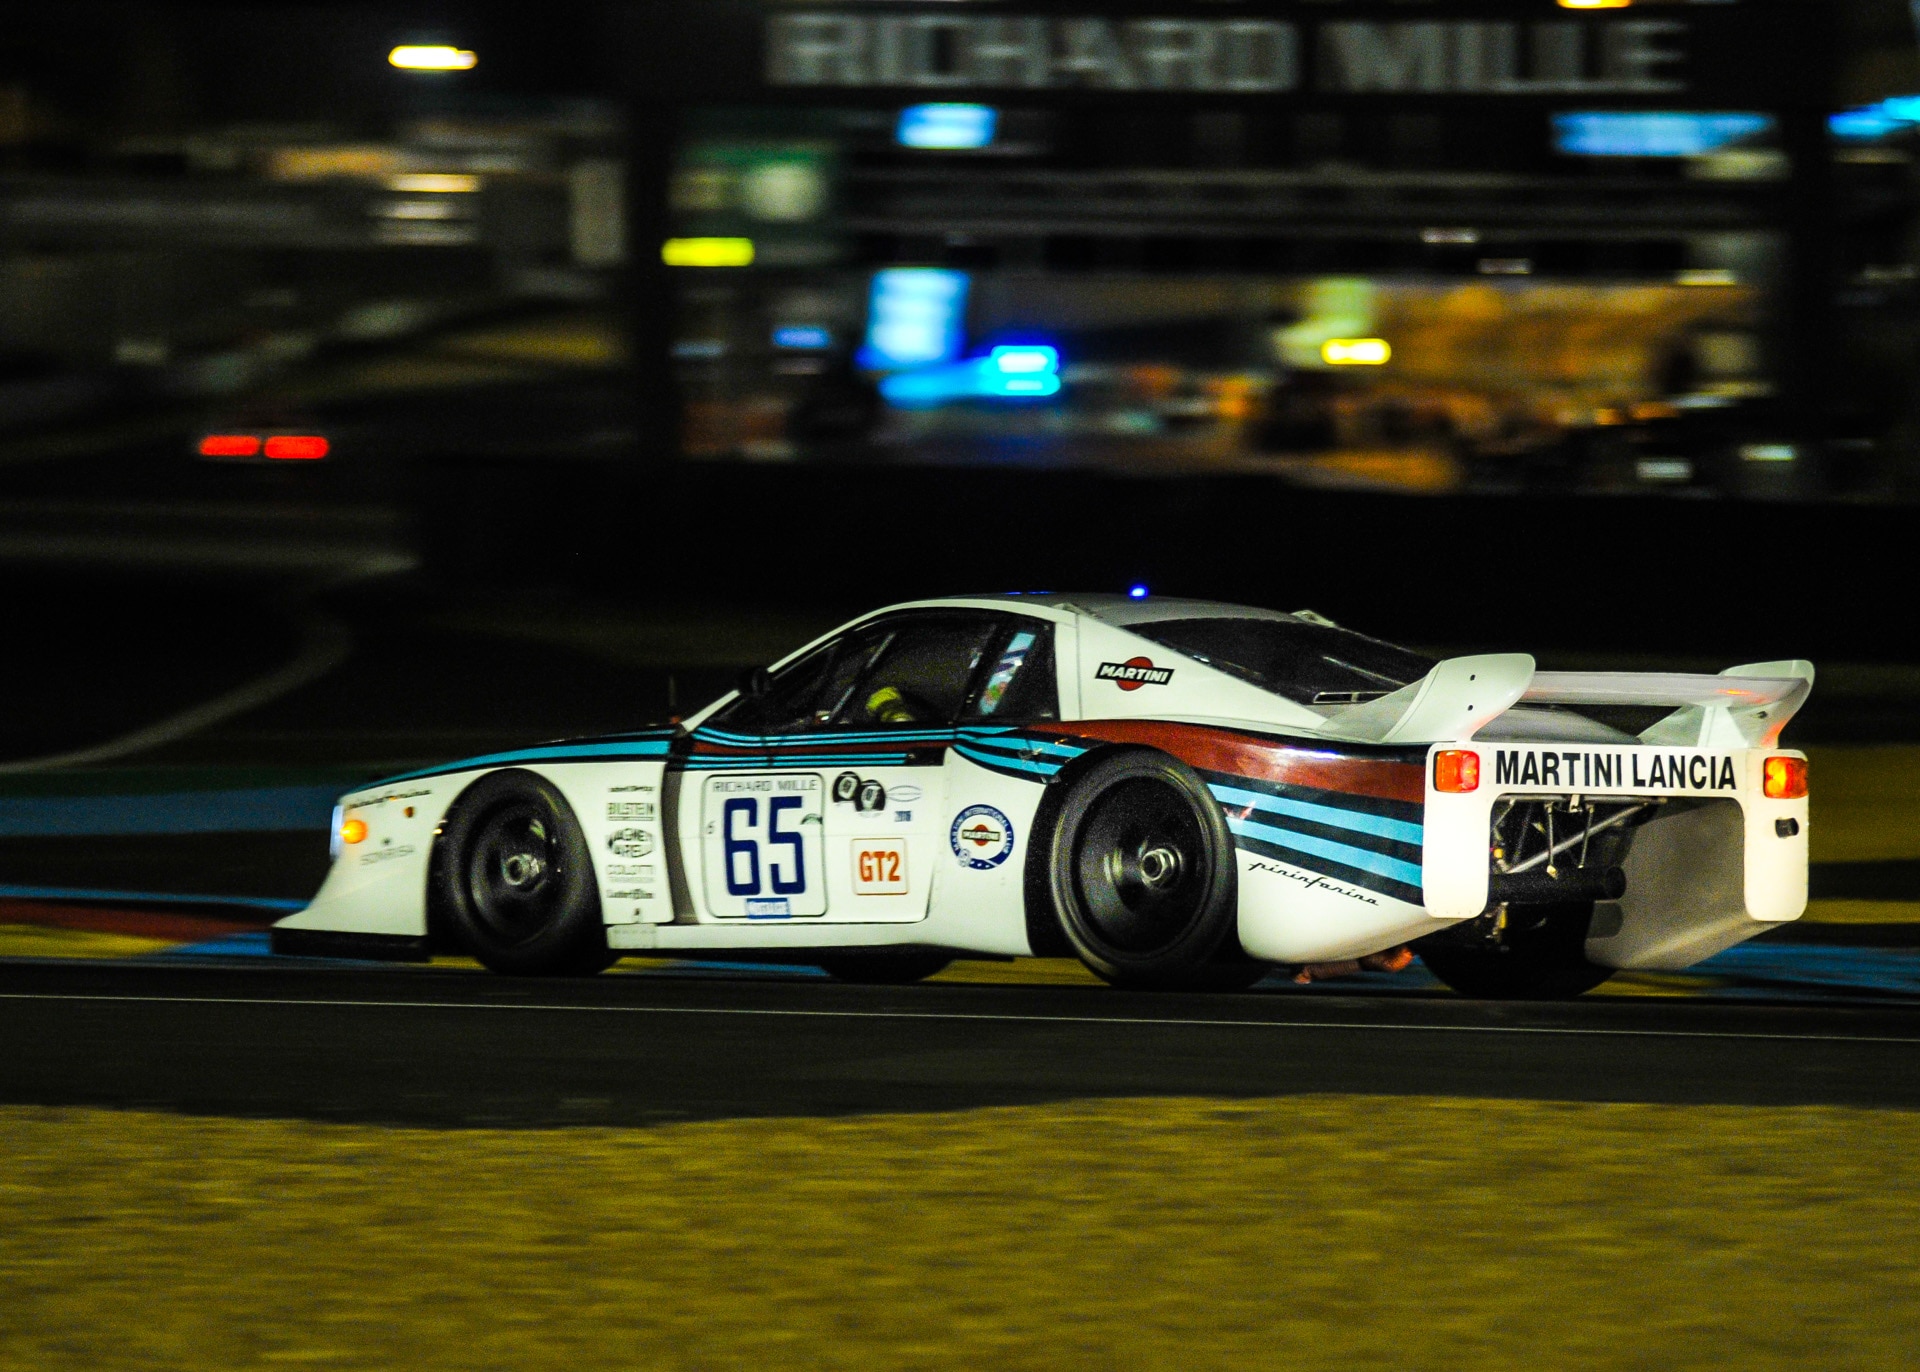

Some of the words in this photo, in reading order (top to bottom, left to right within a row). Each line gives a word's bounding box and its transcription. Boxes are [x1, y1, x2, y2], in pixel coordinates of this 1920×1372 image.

[768, 14, 1299, 90] RICHARD
[1322, 20, 1688, 93] MILLE
[1100, 664, 1169, 682] MARTINI
[777, 779, 818, 792] MILLE
[1496, 750, 1623, 788] MARTINI
[1632, 753, 1737, 790] LANCIA
[724, 795, 806, 896] 65
[858, 850, 902, 882] GT2
[1248, 862, 1380, 907] pininfarina
